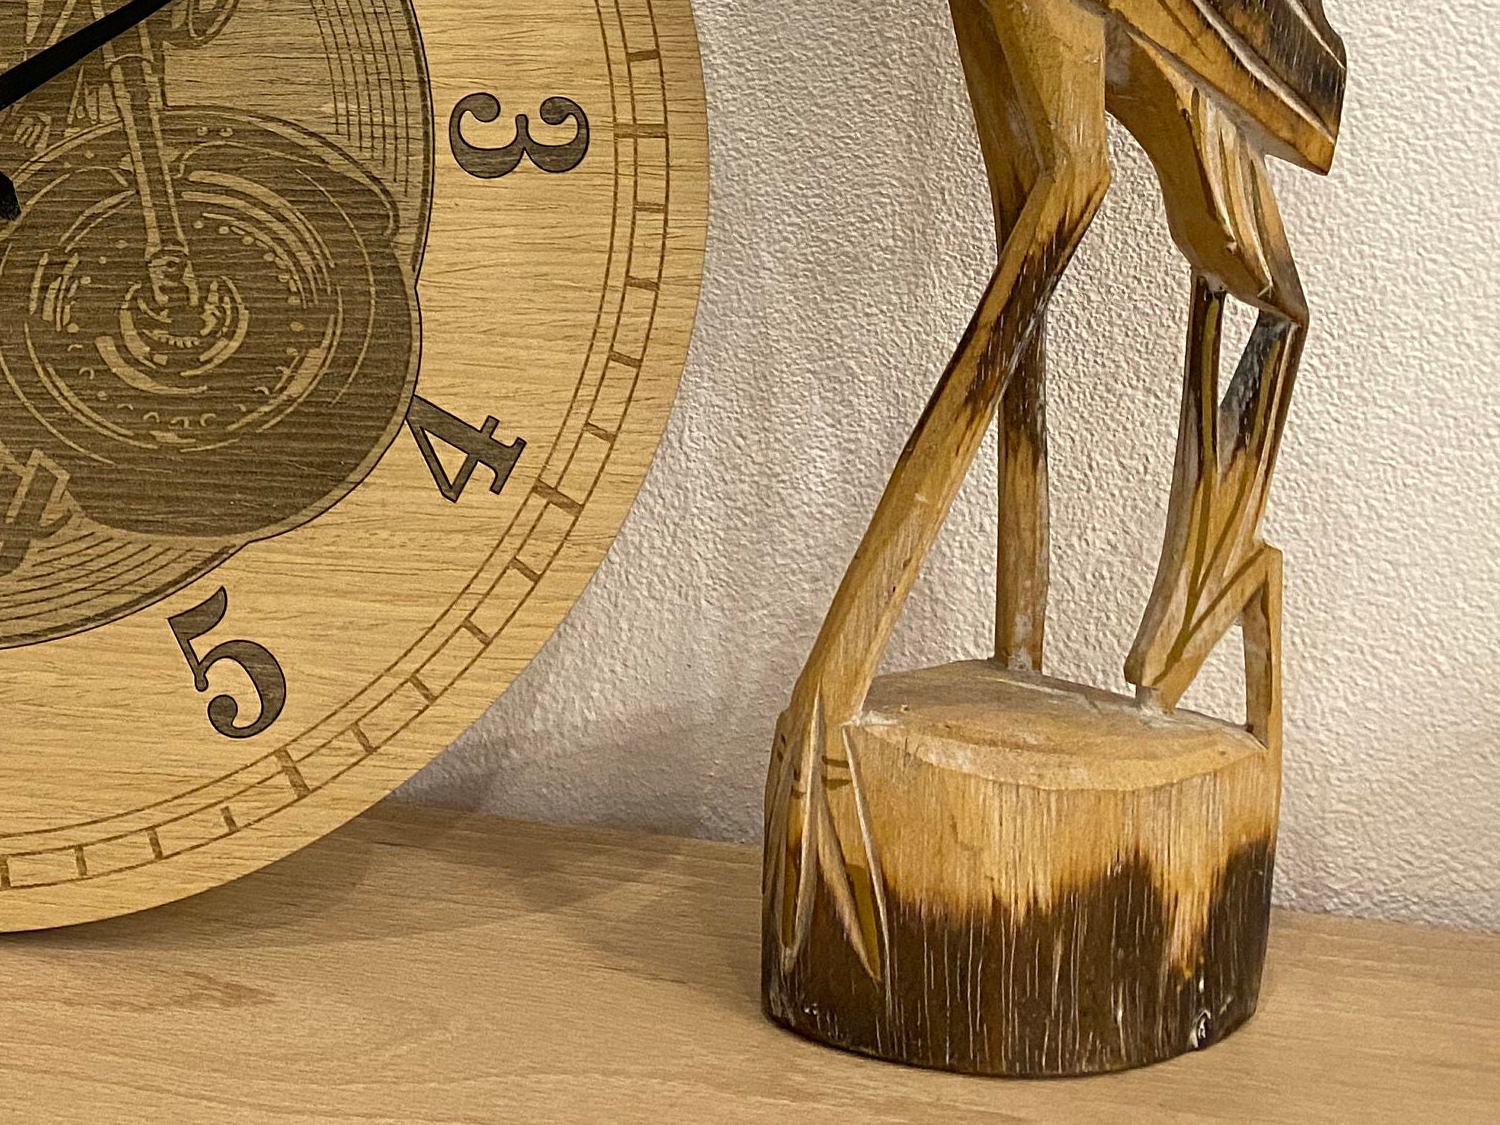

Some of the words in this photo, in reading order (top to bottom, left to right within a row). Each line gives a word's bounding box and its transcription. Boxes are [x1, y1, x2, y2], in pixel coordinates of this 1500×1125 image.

[448, 91, 591, 180] 3
[404, 393, 528, 503] 4
[166, 585, 288, 739] 5
